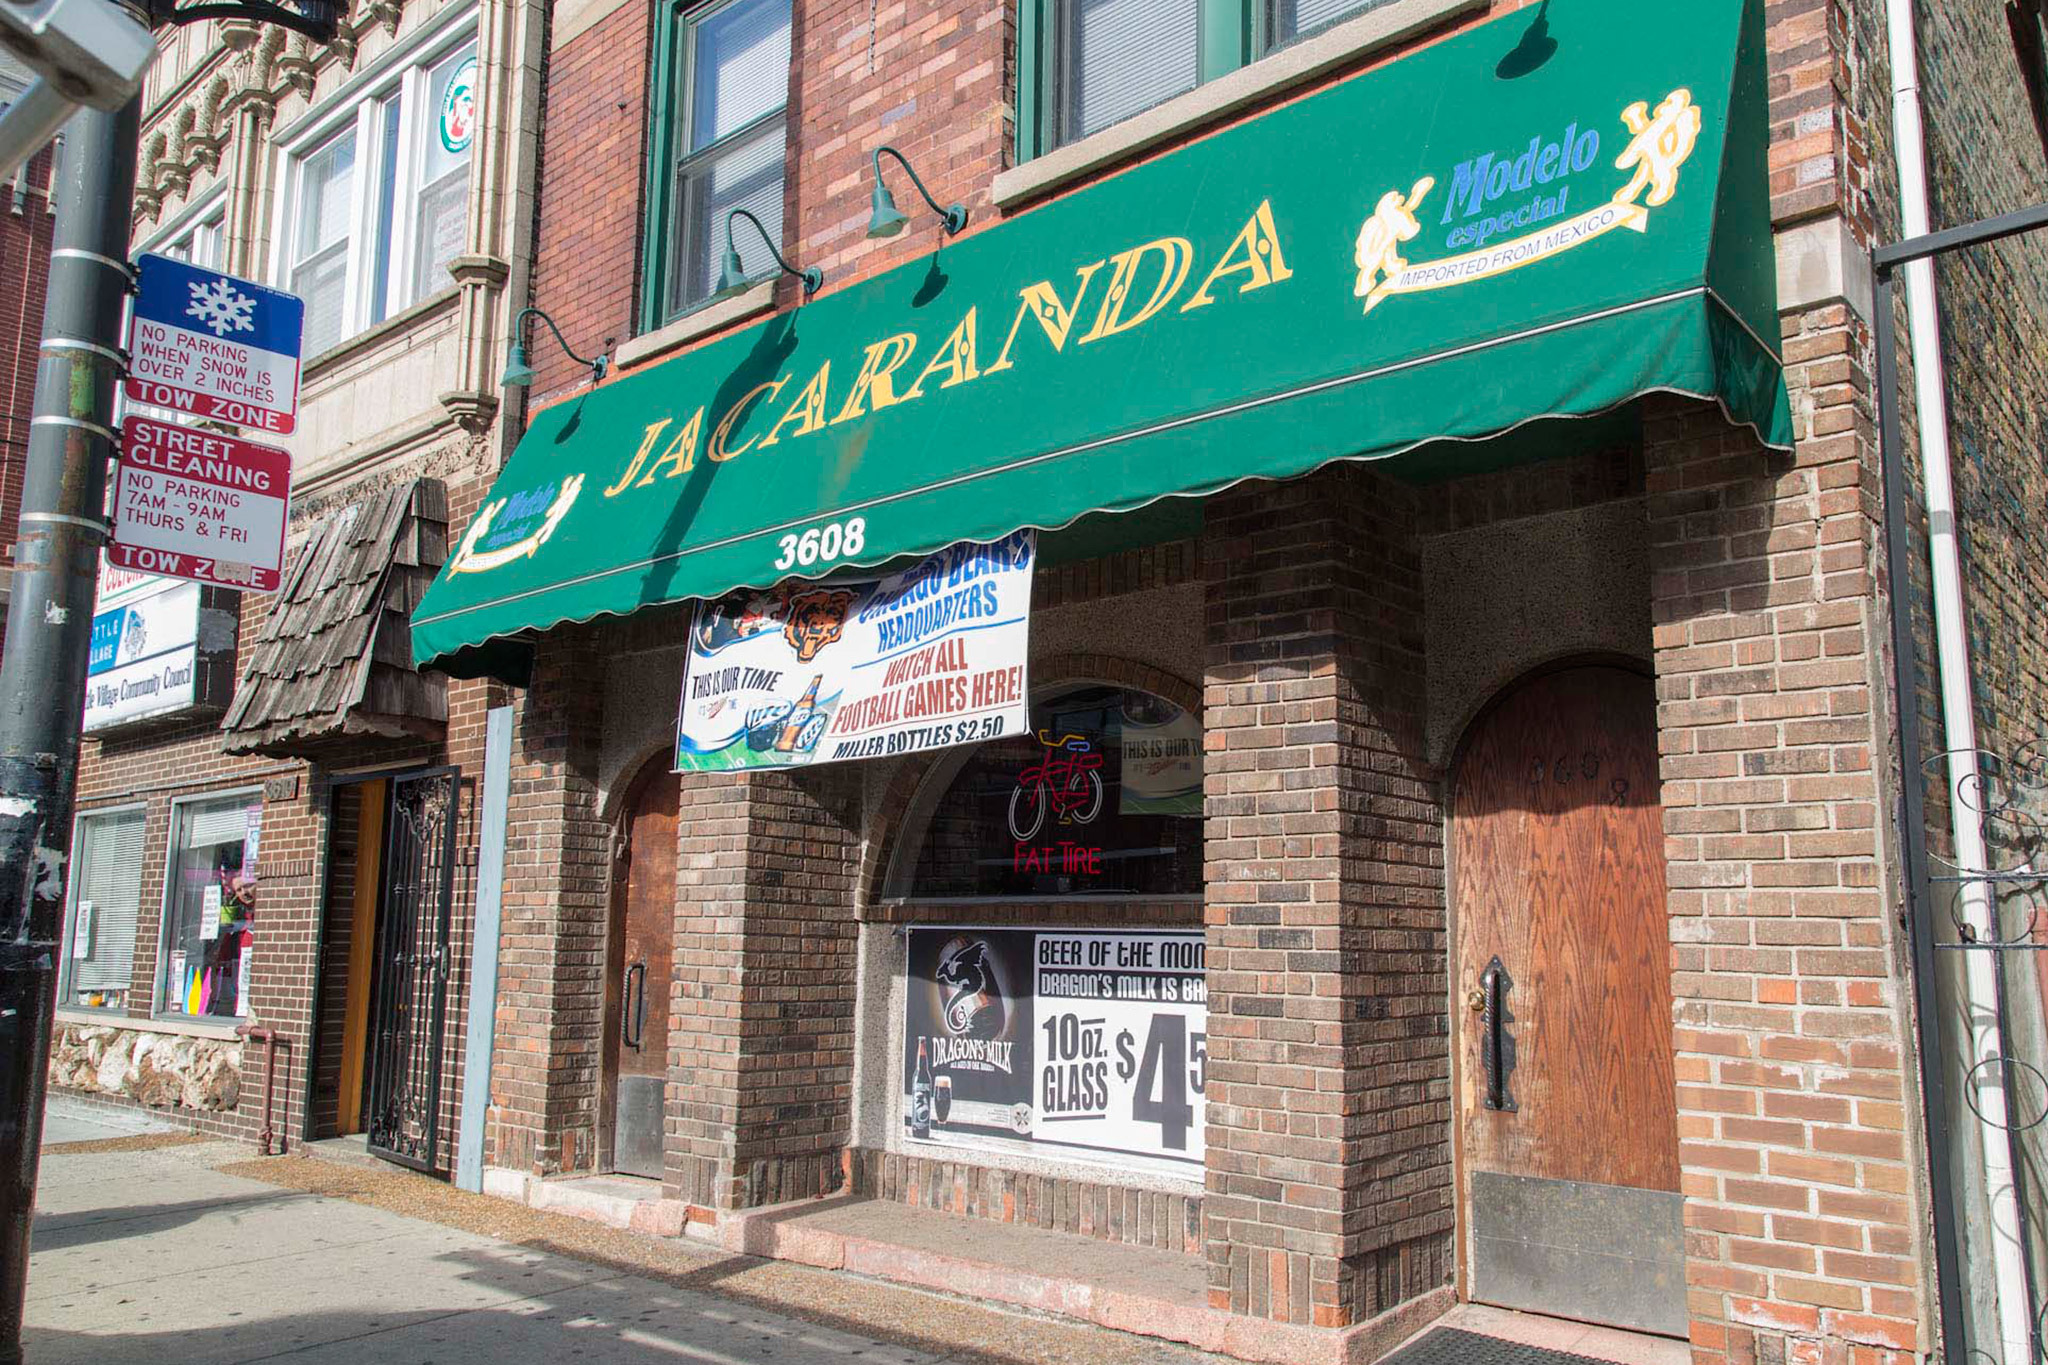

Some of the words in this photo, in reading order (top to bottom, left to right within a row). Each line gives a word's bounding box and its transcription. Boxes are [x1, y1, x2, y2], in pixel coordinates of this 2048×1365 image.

[1441, 122, 1599, 225] Modelo
[1446, 186, 1569, 248] especial
[1492, 242, 1541, 268] FROM
[1544, 209, 1614, 254] MEXICO
[141, 324, 166, 342] NO
[177, 333, 248, 363] PARKING
[141, 341, 190, 366] WHEN
[201, 357, 248, 380] SNOW
[257, 371, 271, 386] IS
[604, 199, 1292, 498] JACARANDA
[138, 358, 184, 381] OVER
[195, 372, 205, 387] 2
[216, 377, 274, 403] INCHES
[136, 380, 196, 411] TOW
[210, 398, 280, 430] ZONE
[134, 422, 235, 461] STREET
[131, 444, 270, 490] CLEANING
[127, 490, 165, 510] 7AM
[188, 502, 226, 522] 9AM
[128, 473, 153, 490] NO
[165, 480, 240, 508] PARKING
[126, 507, 185, 531] THURS
[196, 521, 209, 537] &
[219, 526, 248, 544] FRI
[774, 518, 865, 571] 3608
[121, 545, 180, 573] TOW
[194, 558, 266, 588] ZE
[94, 619, 118, 640] TTLE
[878, 580, 998, 654] HEADQUARTERS
[90, 644, 113, 665] LLAGE
[164, 659, 192, 690] Council
[883, 646, 935, 687] WATCH
[935, 638, 968, 673] ALL
[692, 673, 712, 699] THIS
[713, 670, 721, 695] IS
[722, 667, 740, 693] OUR
[741, 667, 783, 692] TIME
[831, 689, 901, 733] FOOTBALL
[904, 675, 967, 718] GAMES
[972, 665, 1023, 708] HERE!
[832, 736, 884, 759] MILLER
[887, 725, 952, 754] BOTTLES
[956, 715, 1004, 743] $2.50
[1123, 741, 1148, 759] THIS
[1150, 740, 1162, 758] IS
[1165, 738, 1189, 757] OUR
[1014, 842, 1055, 875] FAT
[1056, 841, 1101, 875] TIRE
[1039, 939, 1082, 965] BEER
[1089, 940, 1111, 966] OF
[1160, 942, 1206, 969] MON
[1041, 973, 1113, 998] DRAGON'S
[1117, 975, 1157, 999] MILK
[1162, 977, 1177, 1001] IS
[986, 1041, 1013, 1074] MILK
[1042, 1061, 1108, 1113] GLASS
